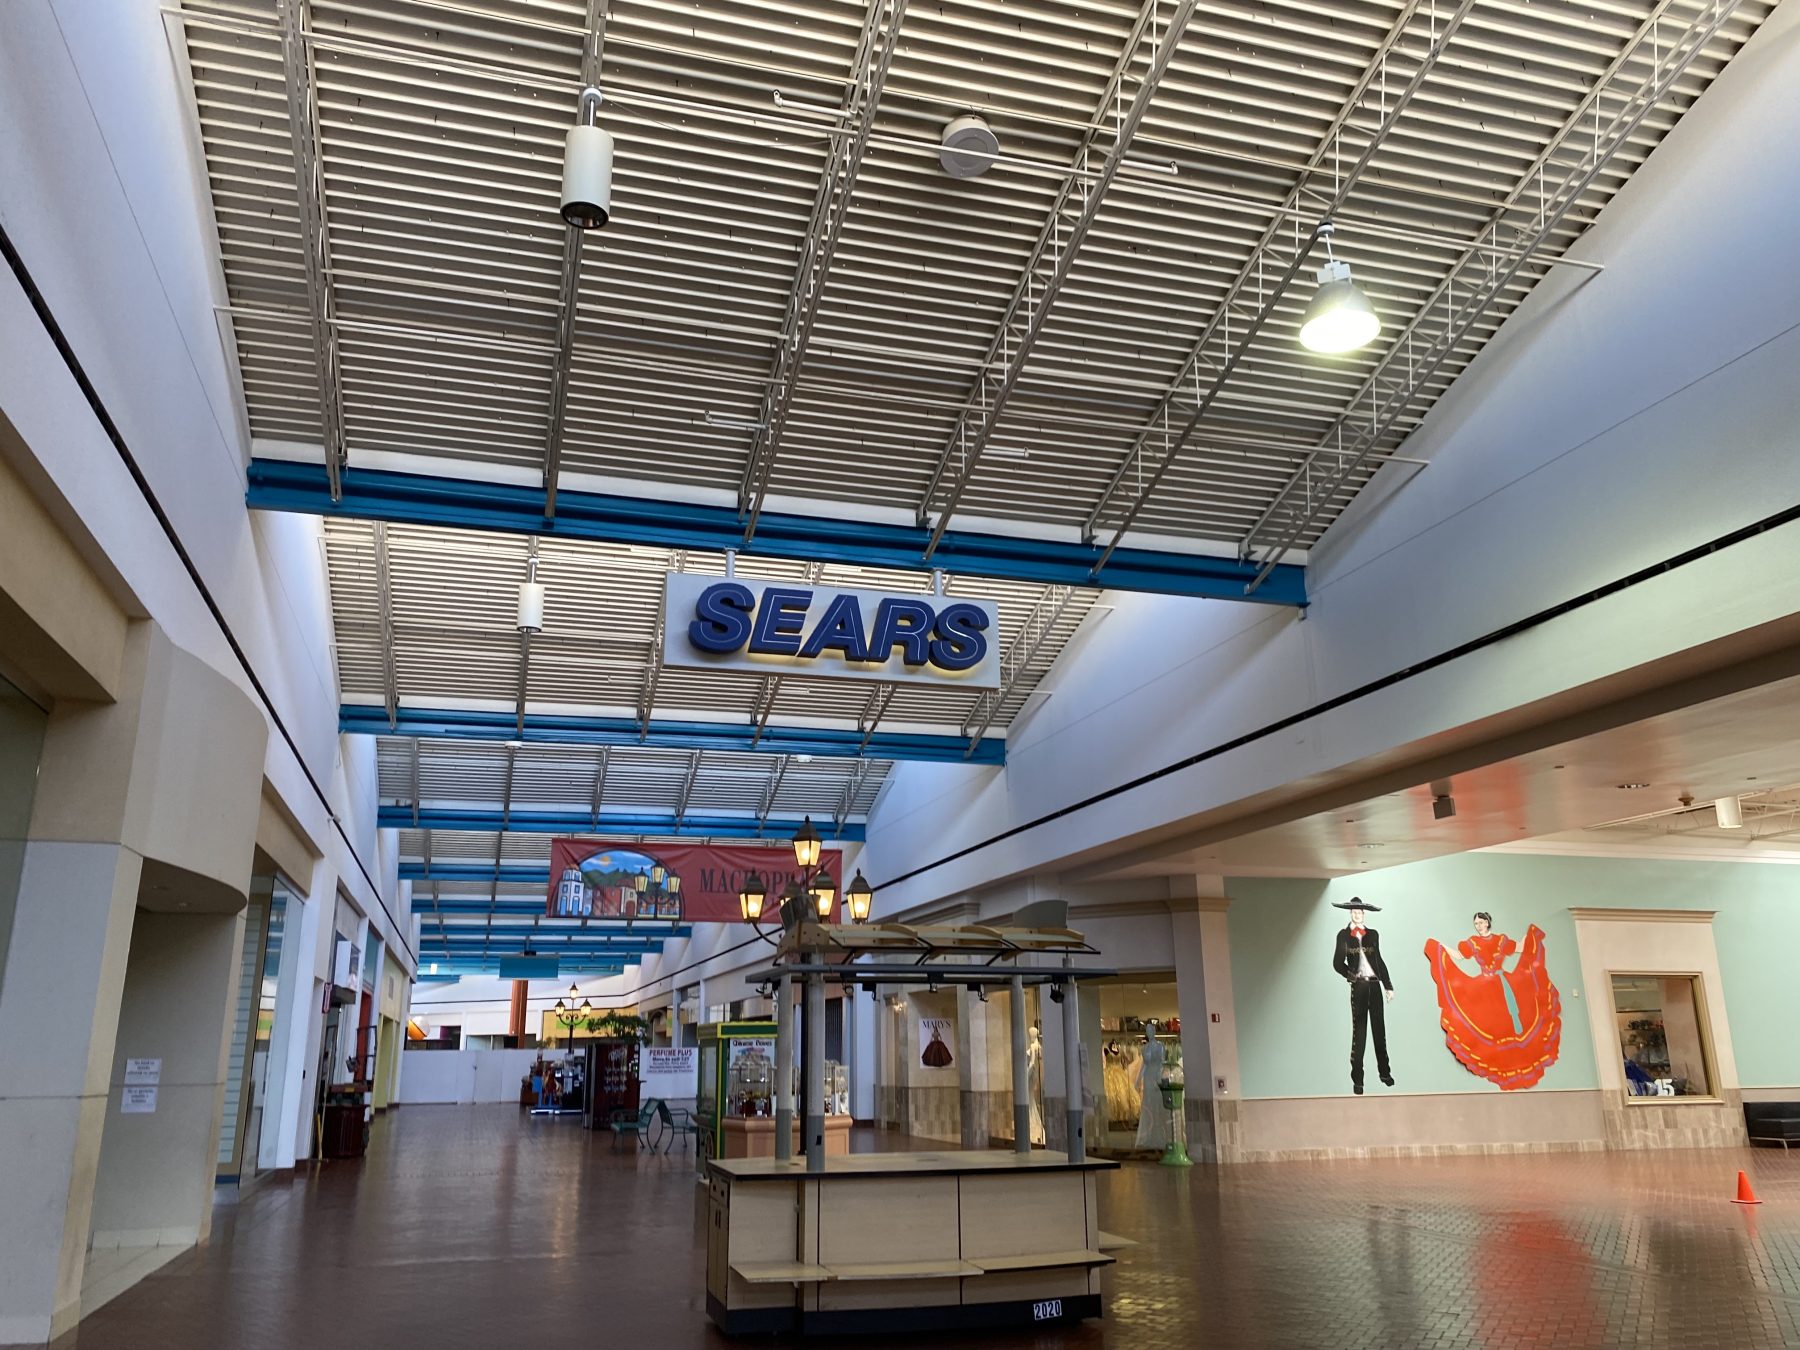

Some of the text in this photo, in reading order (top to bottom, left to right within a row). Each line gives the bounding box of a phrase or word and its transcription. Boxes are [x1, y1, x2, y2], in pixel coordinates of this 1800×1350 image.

[688, 583, 989, 671] SEARS
[650, 1049, 692, 1057] PERFUME PLUS
[1034, 1301, 1061, 1319] 2020
